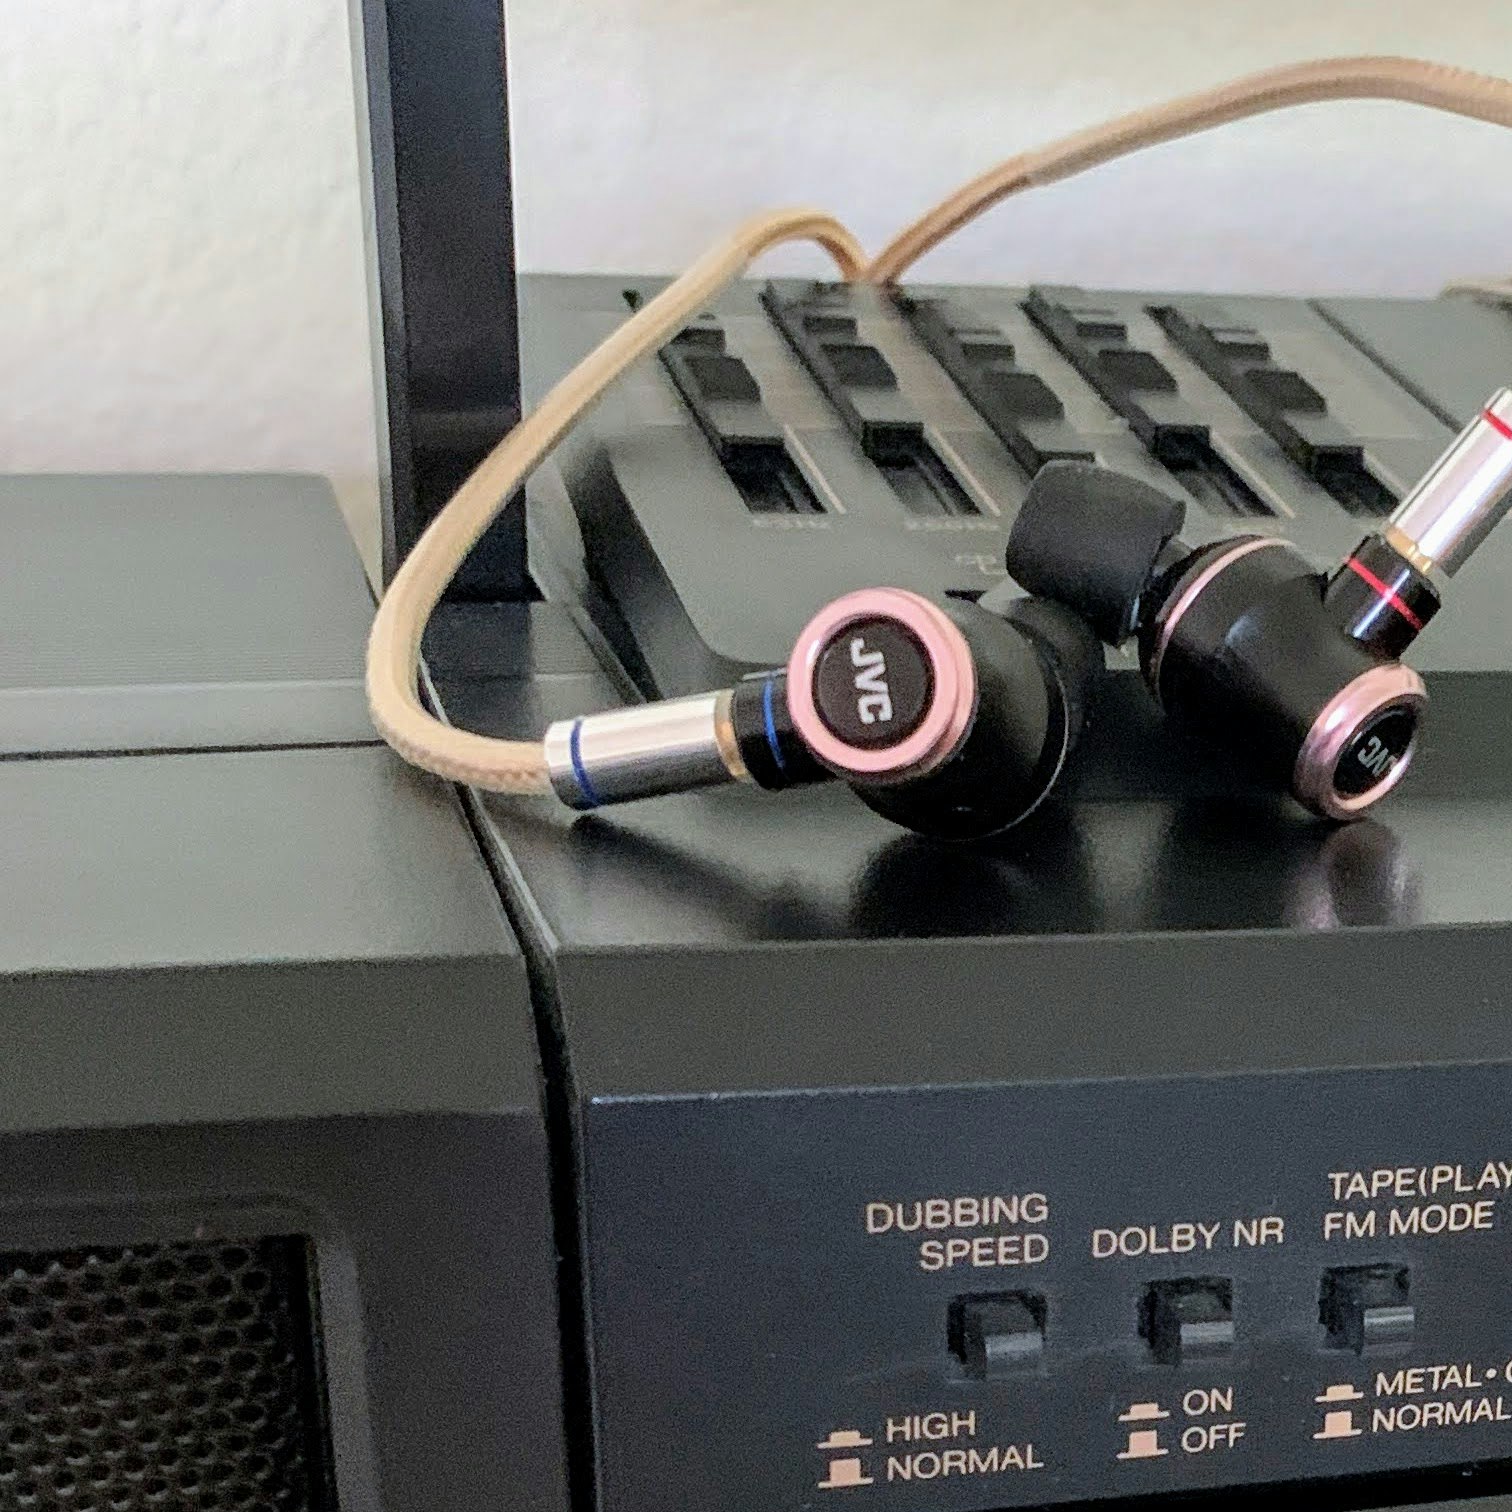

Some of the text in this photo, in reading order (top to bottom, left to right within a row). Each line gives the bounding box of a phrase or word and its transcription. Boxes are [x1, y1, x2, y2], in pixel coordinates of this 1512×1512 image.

[850, 637, 893, 724] JVC
[865, 1193, 1048, 1234] DUBBING
[1324, 1200, 1496, 1241] FM MODE
[919, 1233, 1050, 1272] SPEED
[1092, 1216, 1285, 1259] DOLBY NR
[1182, 1386, 1234, 1416] ON
[1371, 1397, 1512, 1433] NORMAL
[885, 1410, 976, 1443] HIGH
[1181, 1422, 1247, 1453] OFF
[886, 1444, 1044, 1481] NORMAL
